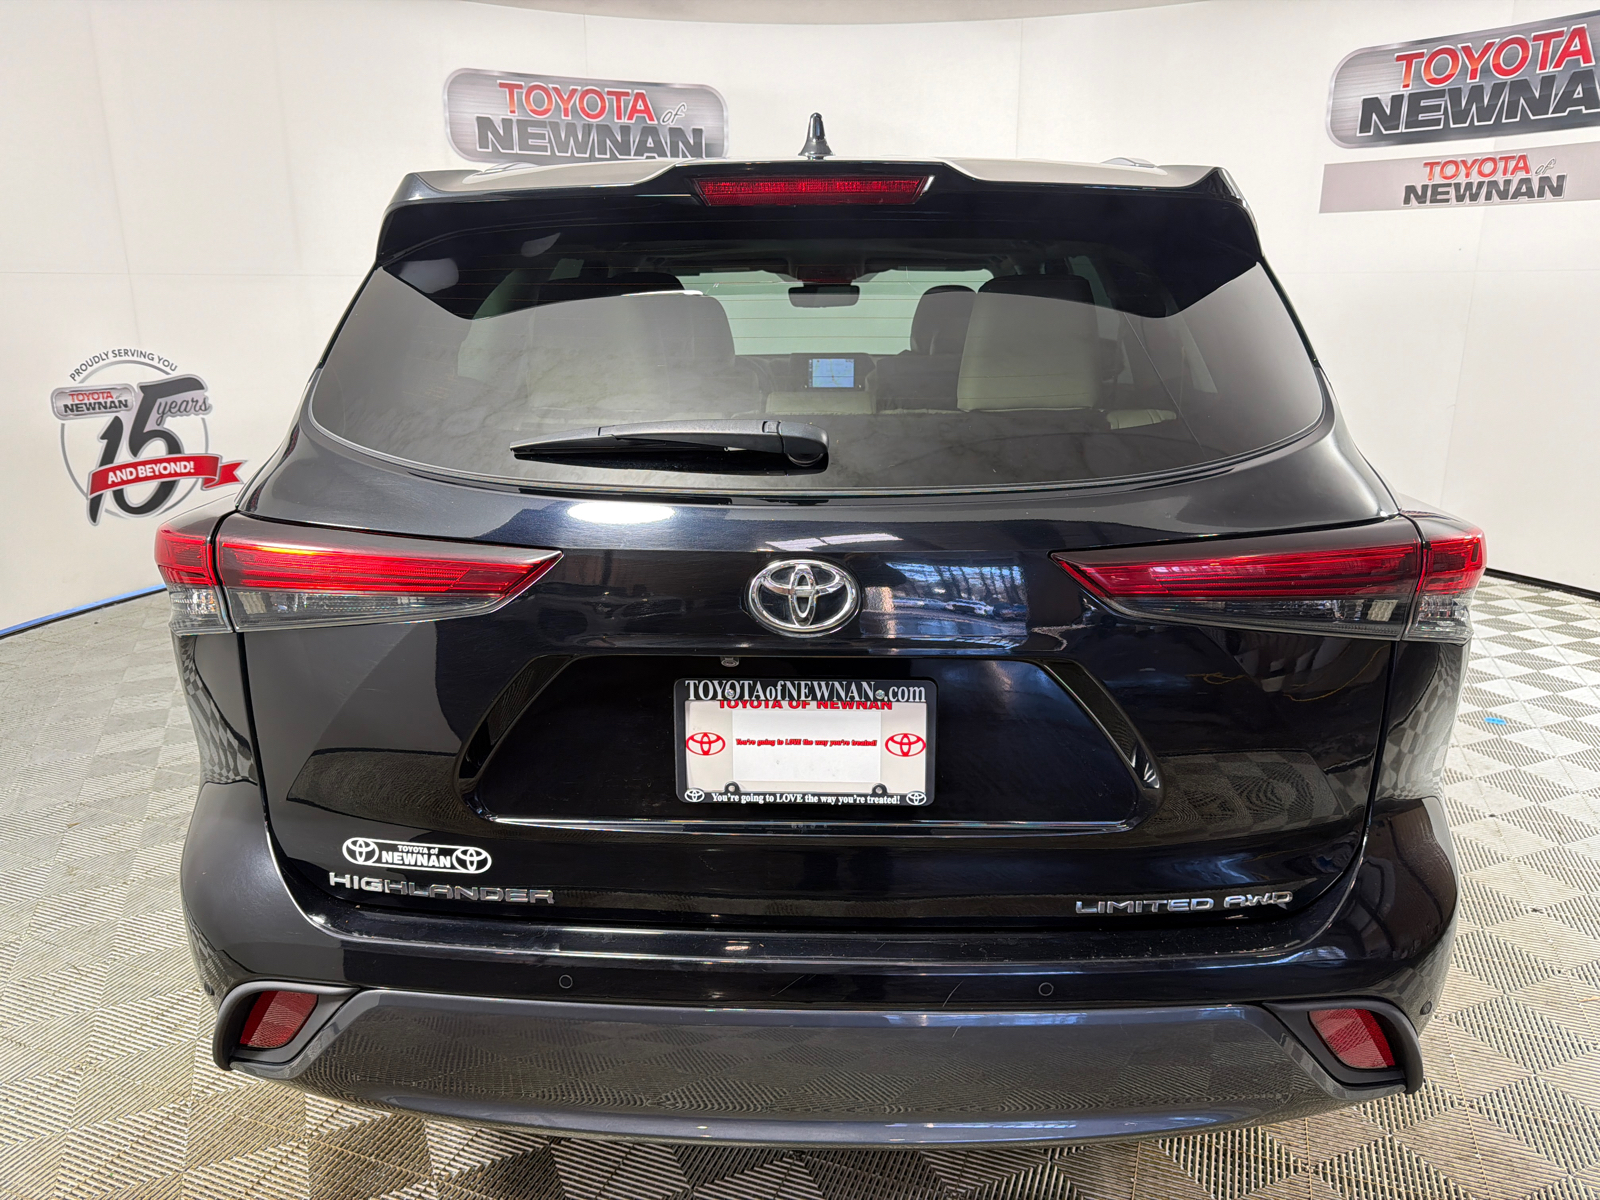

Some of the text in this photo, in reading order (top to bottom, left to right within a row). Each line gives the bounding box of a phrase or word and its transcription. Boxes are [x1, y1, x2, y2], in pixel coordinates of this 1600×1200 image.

[1395, 24, 1595, 89] TOYOTA
[497, 80, 687, 125] TOYOTA of
[475, 115, 706, 159] NEWNAN
[1423, 153, 1556, 181] TOYOTA of
[1402, 174, 1567, 206] NEWNAN
[69, 348, 178, 381] PROUDLY SERVING YOU
[63, 399, 128, 413] NEWNAN
[68, 391, 114, 402] TOYOTA
[156, 396, 210, 426] years
[107, 461, 195, 484] AND BEYOND!
[719, 700, 892, 711] TOYOTA OF NEWNAN
[757, 739, 775, 747] going
[712, 793, 900, 805] You're going to LOVE the way you're treated!
[381, 851, 451, 868] NEWNAN
[397, 845, 439, 855] TOYOTA of
[329, 872, 555, 904] HIGHLANDER
[1075, 891, 1293, 914] LIMITED AWD
